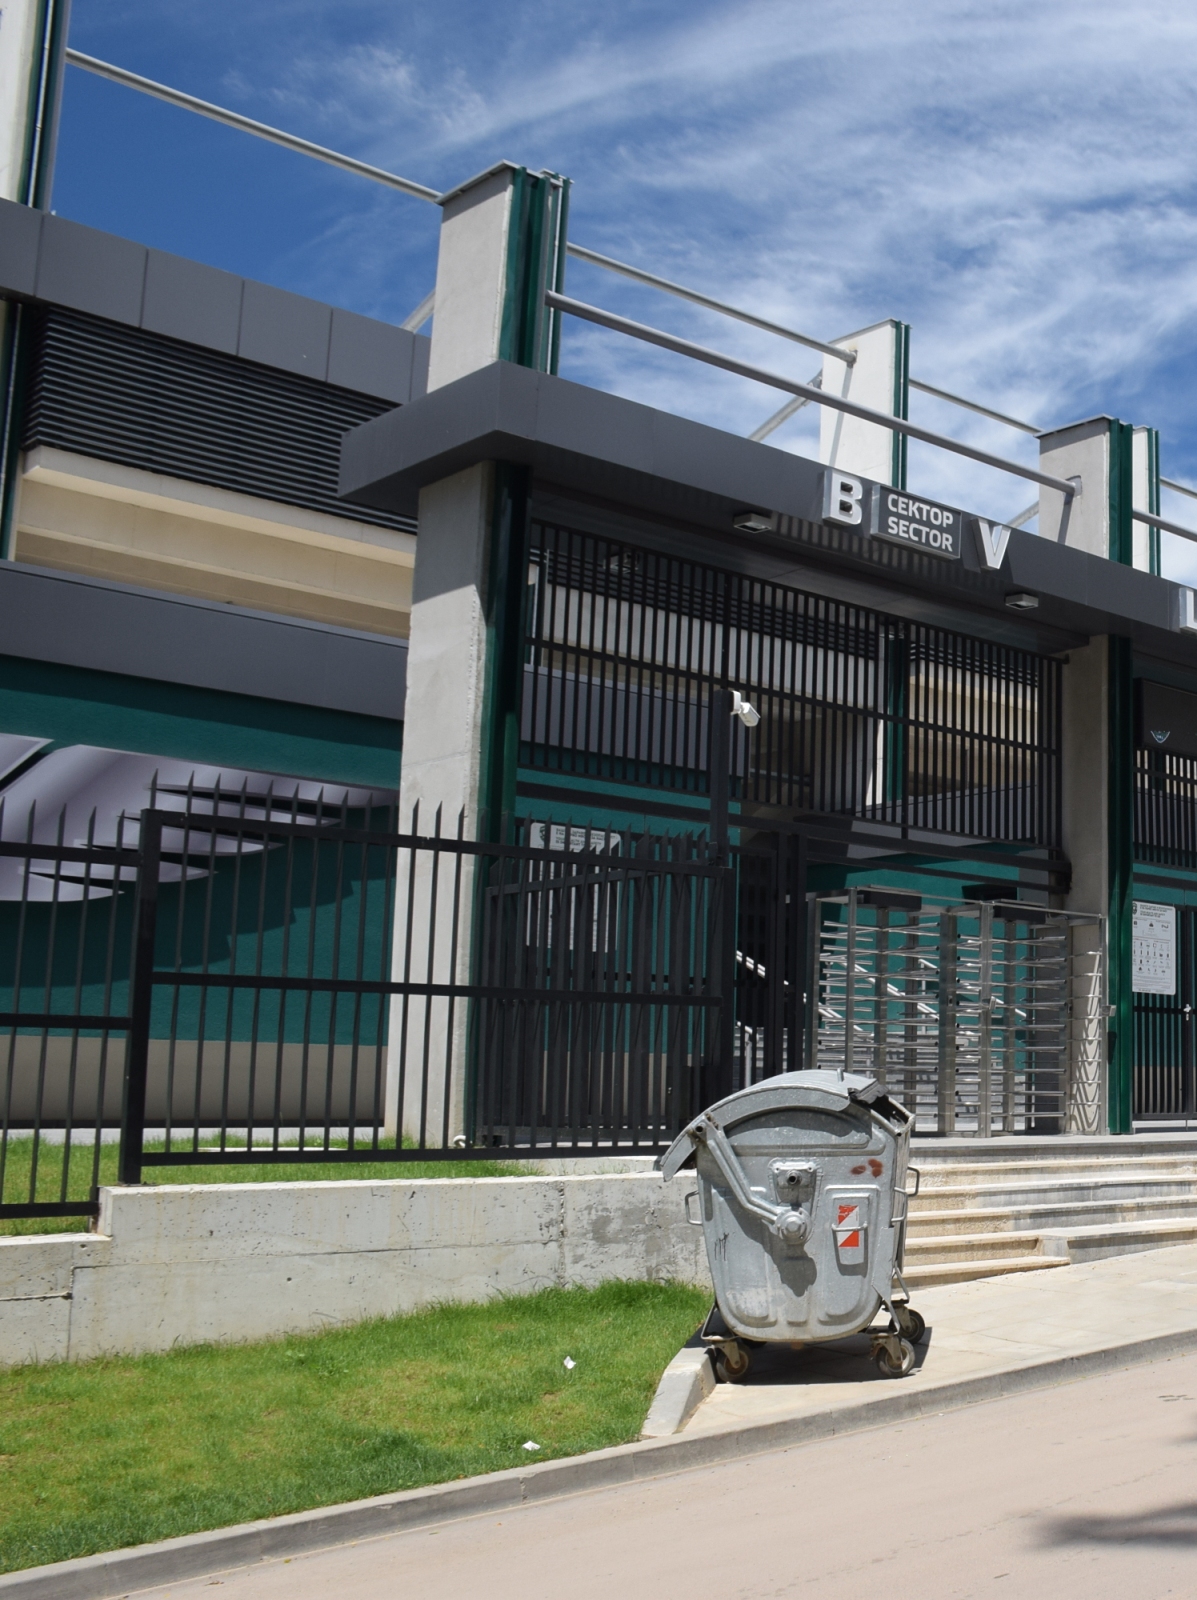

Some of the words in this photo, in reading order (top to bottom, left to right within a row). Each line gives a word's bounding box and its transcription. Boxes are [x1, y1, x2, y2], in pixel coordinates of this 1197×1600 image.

[887, 494, 953, 527] СЕКТОР
[888, 517, 953, 552] SECTOR
[978, 517, 1011, 570] V
